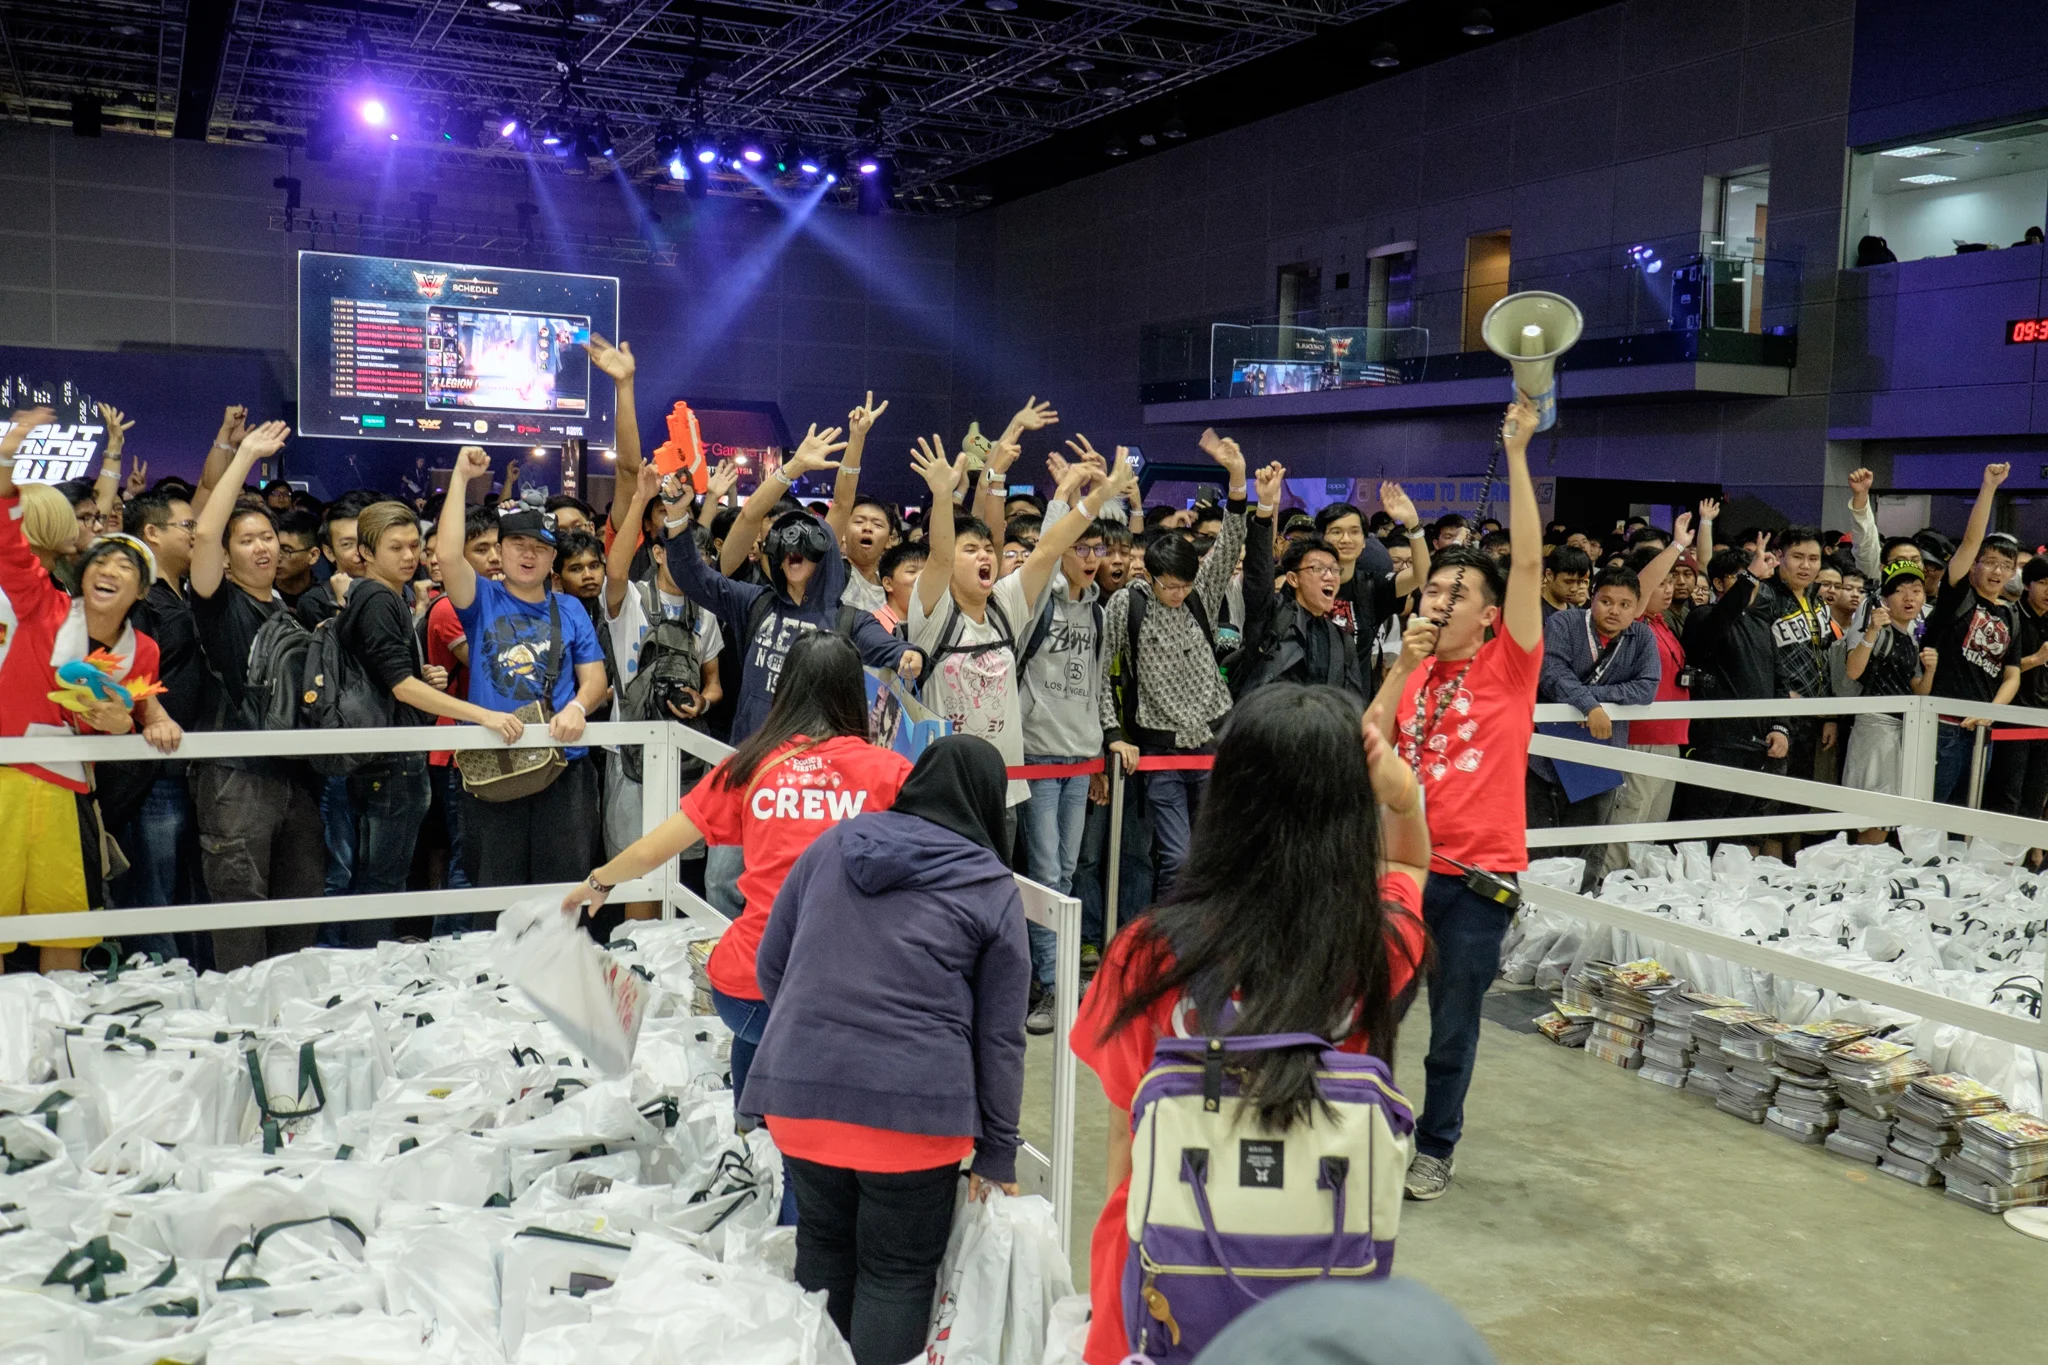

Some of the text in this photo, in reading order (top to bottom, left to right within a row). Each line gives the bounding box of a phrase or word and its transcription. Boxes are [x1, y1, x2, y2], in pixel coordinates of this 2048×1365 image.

[452, 284, 498, 294] SCHEDULE
[440, 377, 473, 389] LEGION
[1044, 680, 1062, 692] LOS
[752, 788, 867, 820] CREW
